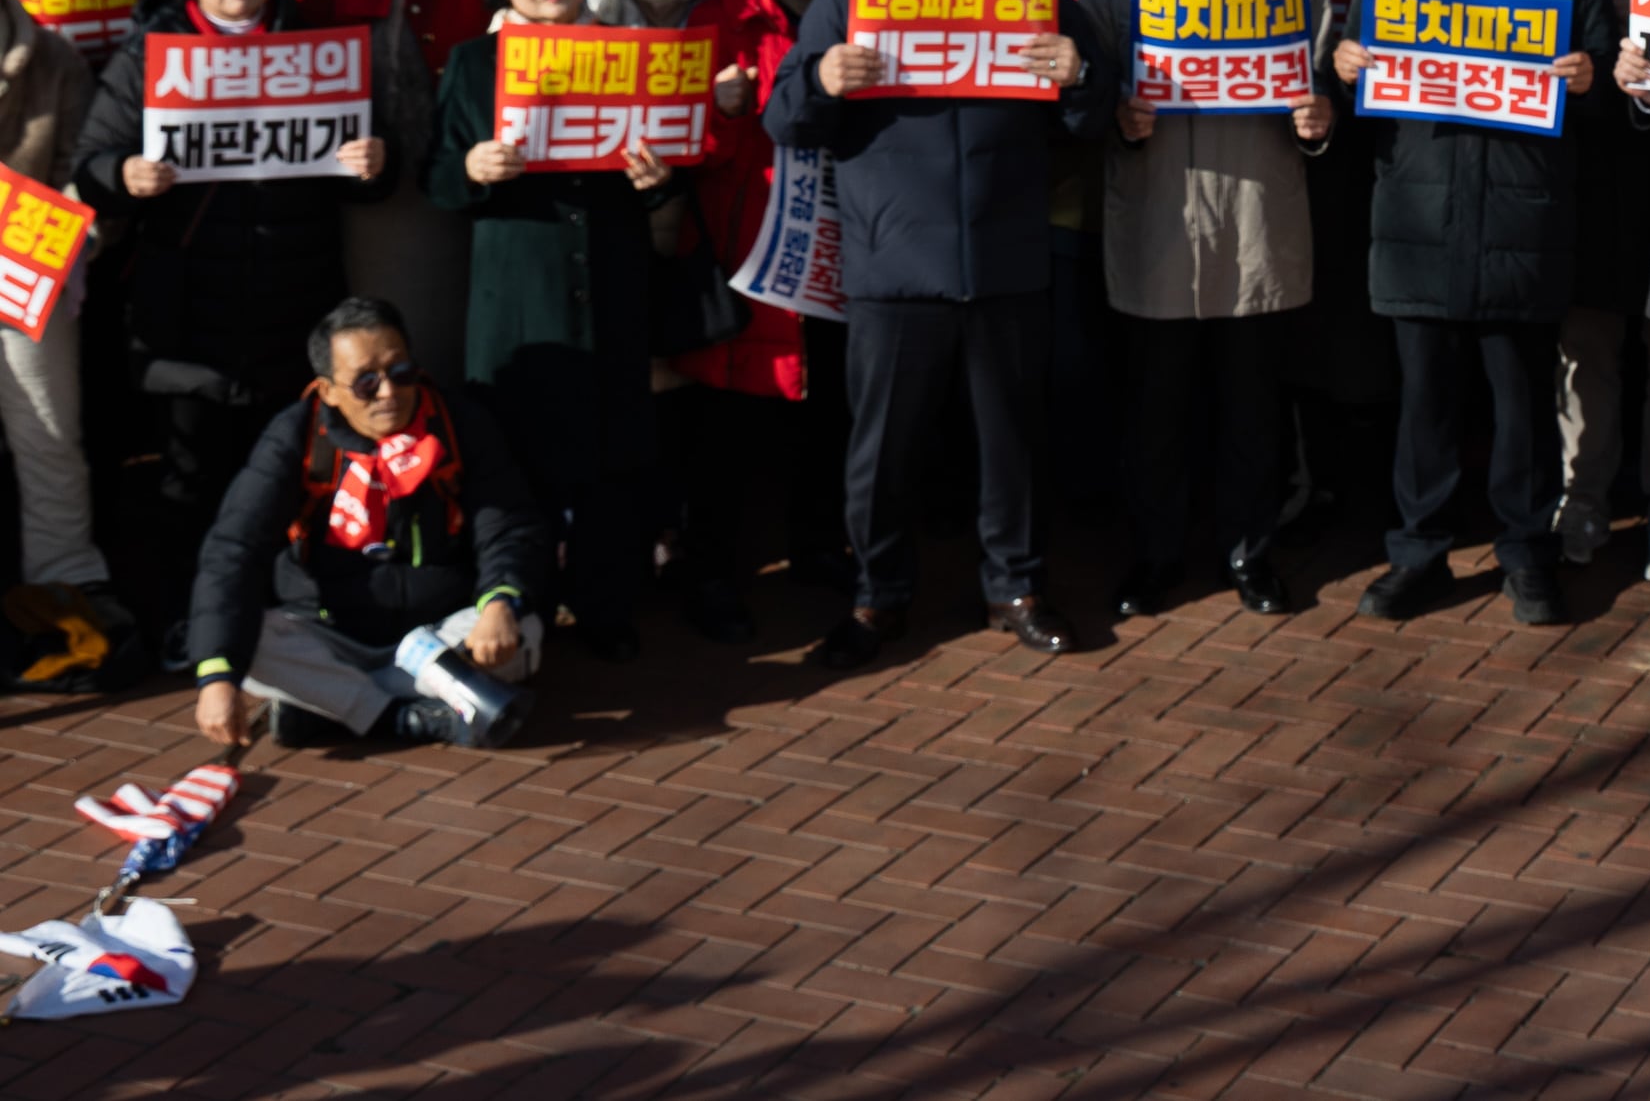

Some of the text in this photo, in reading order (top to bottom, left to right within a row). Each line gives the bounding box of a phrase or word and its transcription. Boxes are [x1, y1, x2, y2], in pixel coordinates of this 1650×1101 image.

[155, 38, 362, 100] 사법정의
[504, 35, 712, 96] 민생파괴 정권
[1136, 46, 1309, 102] 검열정권
[1371, 52, 1551, 119] 검열정권
[502, 102, 707, 161] 레드카드!
[2, 190, 85, 270] 정권
